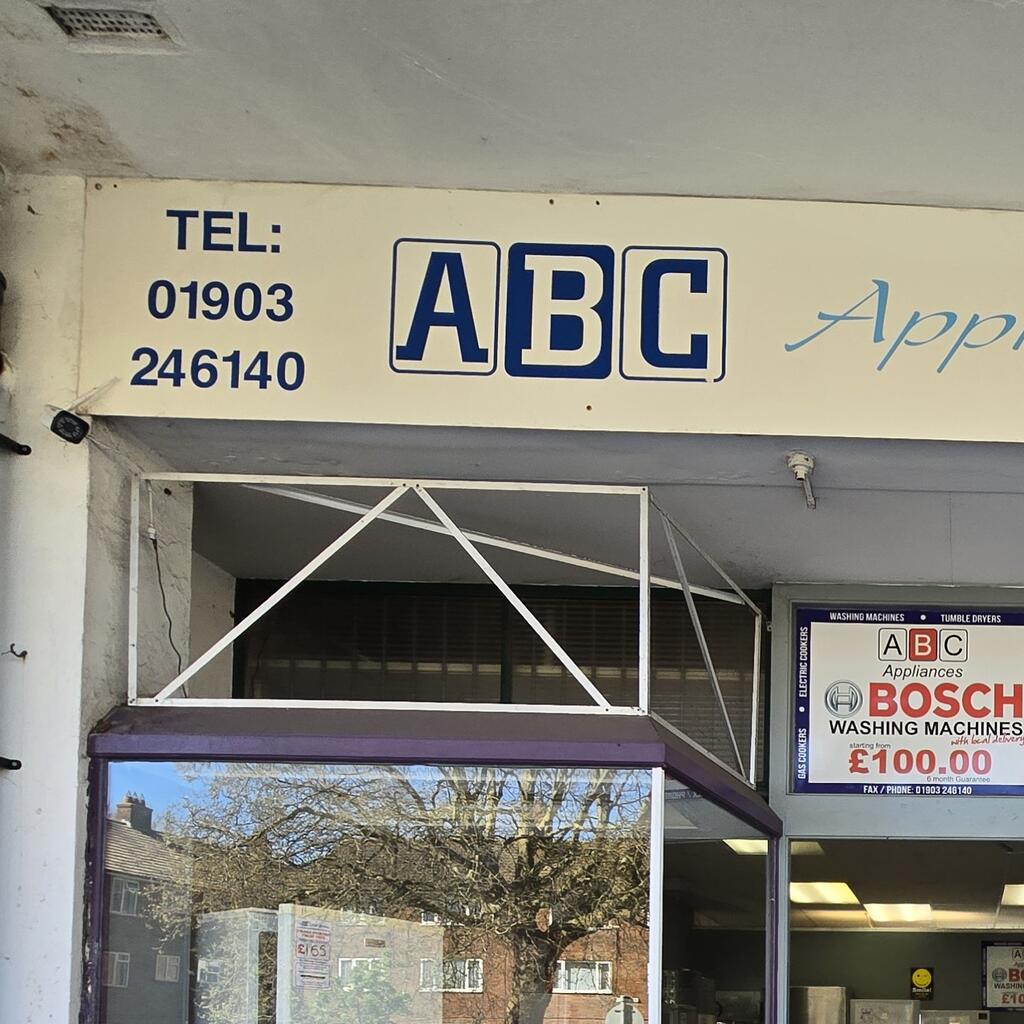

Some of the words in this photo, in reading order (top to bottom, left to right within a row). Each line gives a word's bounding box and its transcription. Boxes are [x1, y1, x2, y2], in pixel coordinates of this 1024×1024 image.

[166, 209, 281, 253] TEL:
[147, 279, 294, 323] 01903
[395, 248, 710, 371] ABC
[130, 346, 305, 392] 246140
[829, 612, 864, 622] WASHING
[865, 612, 905, 622] MACHINES
[940, 614, 971, 623] TUMBLE
[972, 614, 1001, 623] DRYERS
[799, 626, 808, 663] COOKERS
[880, 631, 965, 658] ABC
[799, 664, 808, 697] ELECTRIC
[882, 664, 963, 679] Appliances
[868, 682, 1023, 718] BOSCH
[829, 720, 918, 736] WASHING
[924, 720, 1023, 736] MACHINES
[951, 736, 969, 746] with
[971, 735, 991, 745] local
[798, 728, 807, 764] COOKERS
[849, 742, 875, 750] starting
[798, 766, 807, 779] GAS
[848, 749, 992, 775] £100.00
[863, 785, 879, 794] FAX
[886, 785, 914, 794] PHONE:
[915, 785, 940, 795] 01903
[942, 786, 972, 795] 246140
